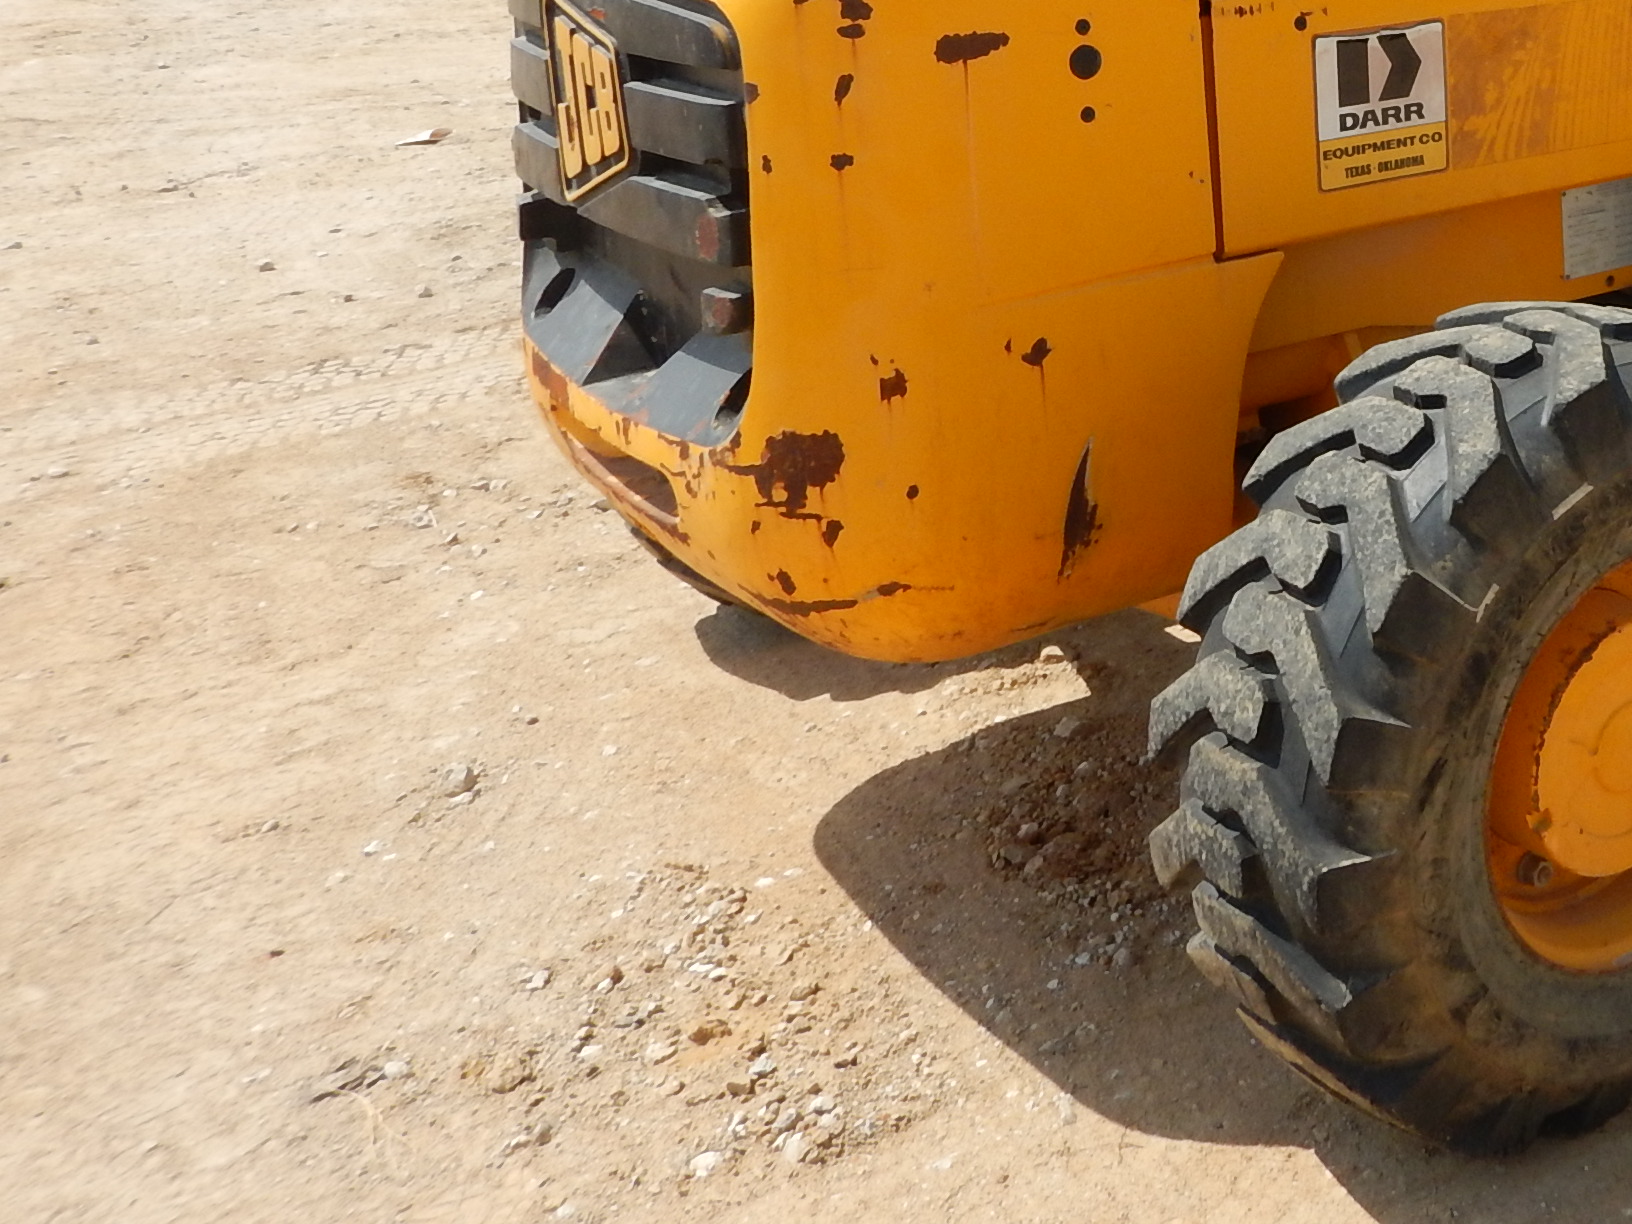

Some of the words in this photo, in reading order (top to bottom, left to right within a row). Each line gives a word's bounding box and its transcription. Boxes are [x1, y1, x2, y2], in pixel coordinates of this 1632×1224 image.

[553, 14, 620, 179] JCB
[1339, 102, 1425, 132] DARR
[1322, 135, 1417, 161] EQUIPMENT
[1418, 131, 1443, 145] CO
[1344, 163, 1372, 179] TEXAS
[1377, 154, 1424, 173] OKLAHOMA
